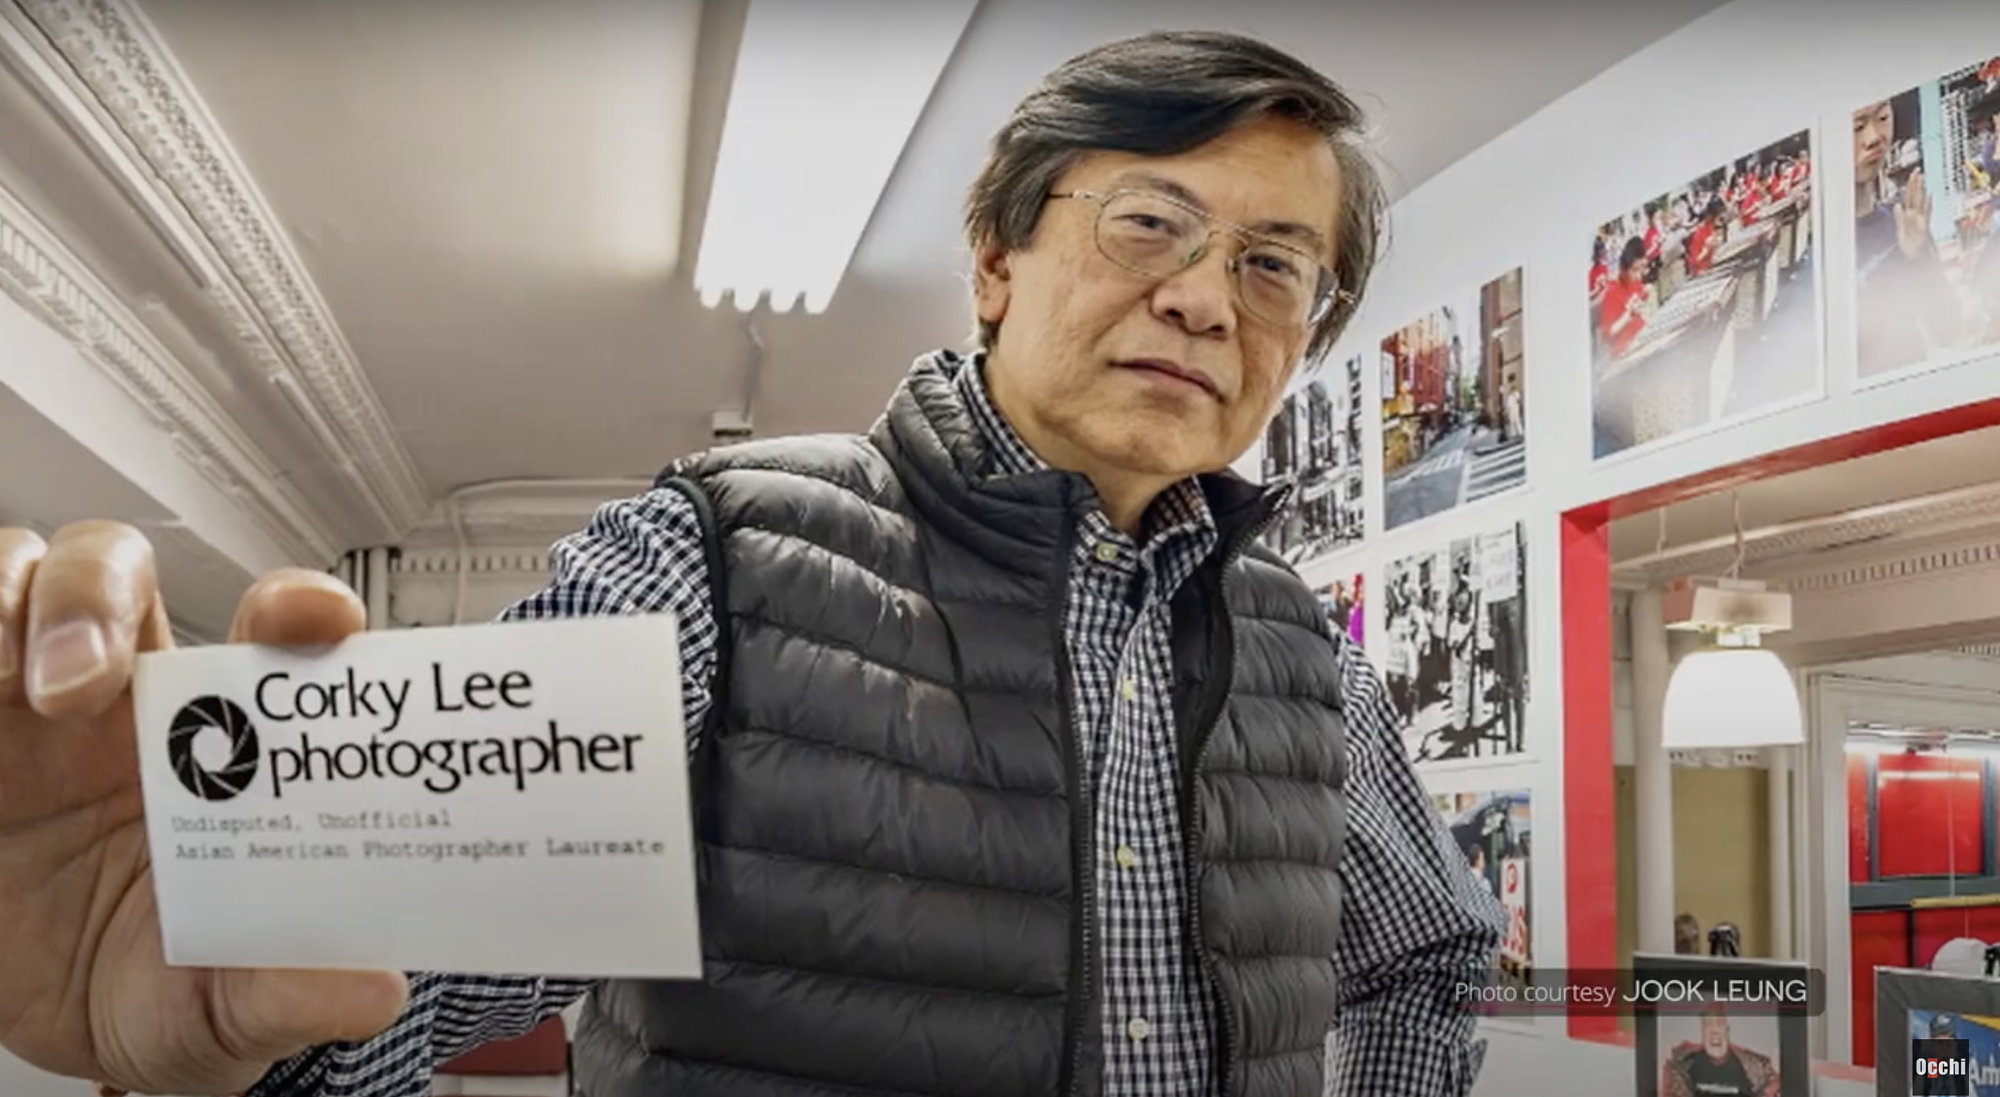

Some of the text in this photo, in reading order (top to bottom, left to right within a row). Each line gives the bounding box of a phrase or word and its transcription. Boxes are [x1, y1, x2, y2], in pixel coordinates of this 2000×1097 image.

[255, 663, 532, 732] Corky Lee
[268, 721, 643, 797] photographer
[171, 809, 451, 836] Undisputed, Unofficial
[175, 836, 665, 862] Asian American Photographer Laureate
